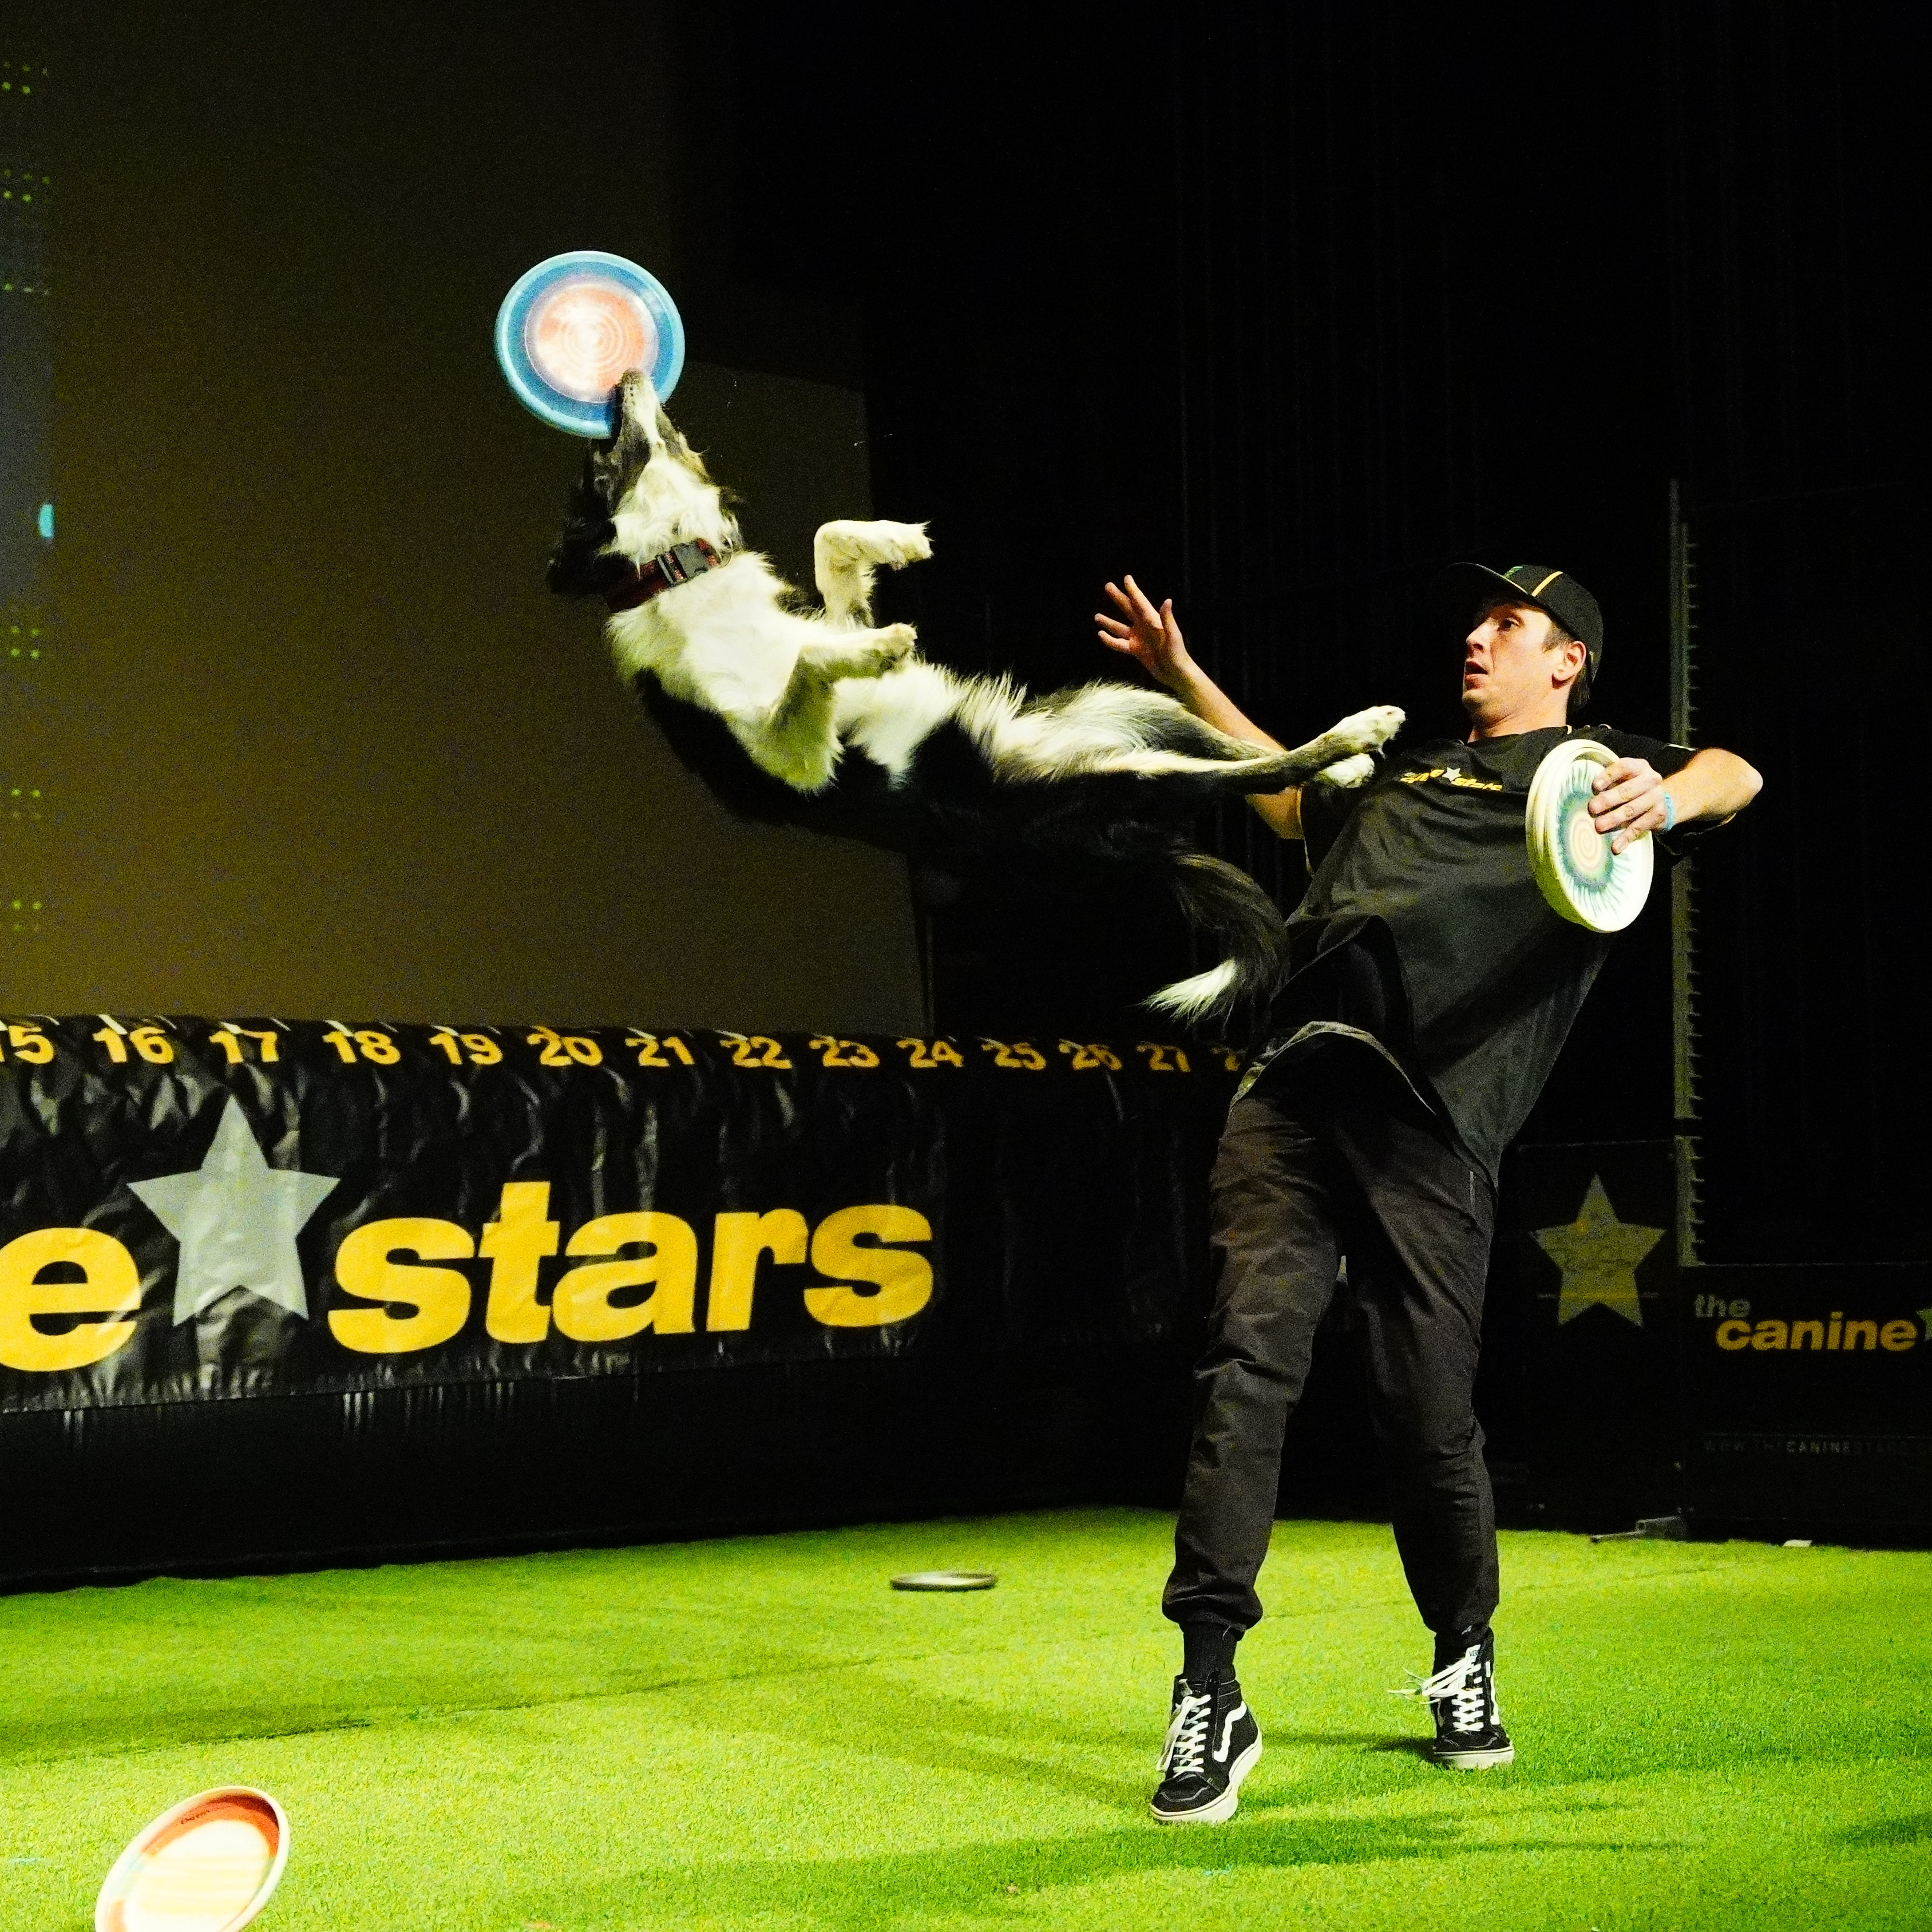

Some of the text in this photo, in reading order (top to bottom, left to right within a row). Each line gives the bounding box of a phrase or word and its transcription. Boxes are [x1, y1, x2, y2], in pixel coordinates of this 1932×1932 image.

[0, 1024, 54, 1064] 5
[92, 1027, 174, 1064] 16
[209, 1030, 279, 1064] 17
[323, 1030, 401, 1065] 18
[429, 1032, 503, 1065] 19
[526, 1026, 603, 1067] 20
[625, 1036, 695, 1067] 21
[719, 1036, 793, 1069] 22
[809, 1036, 880, 1068] 23
[897, 1038, 964, 1068] 24
[980, 1040, 1047, 1071] 25
[1058, 1040, 1122, 1071] 26
[1136, 1042, 1191, 1072] 27
[327, 1181, 934, 1353] stars
[1694, 1293, 1751, 1317] the
[1716, 1311, 1918, 1351] canine
